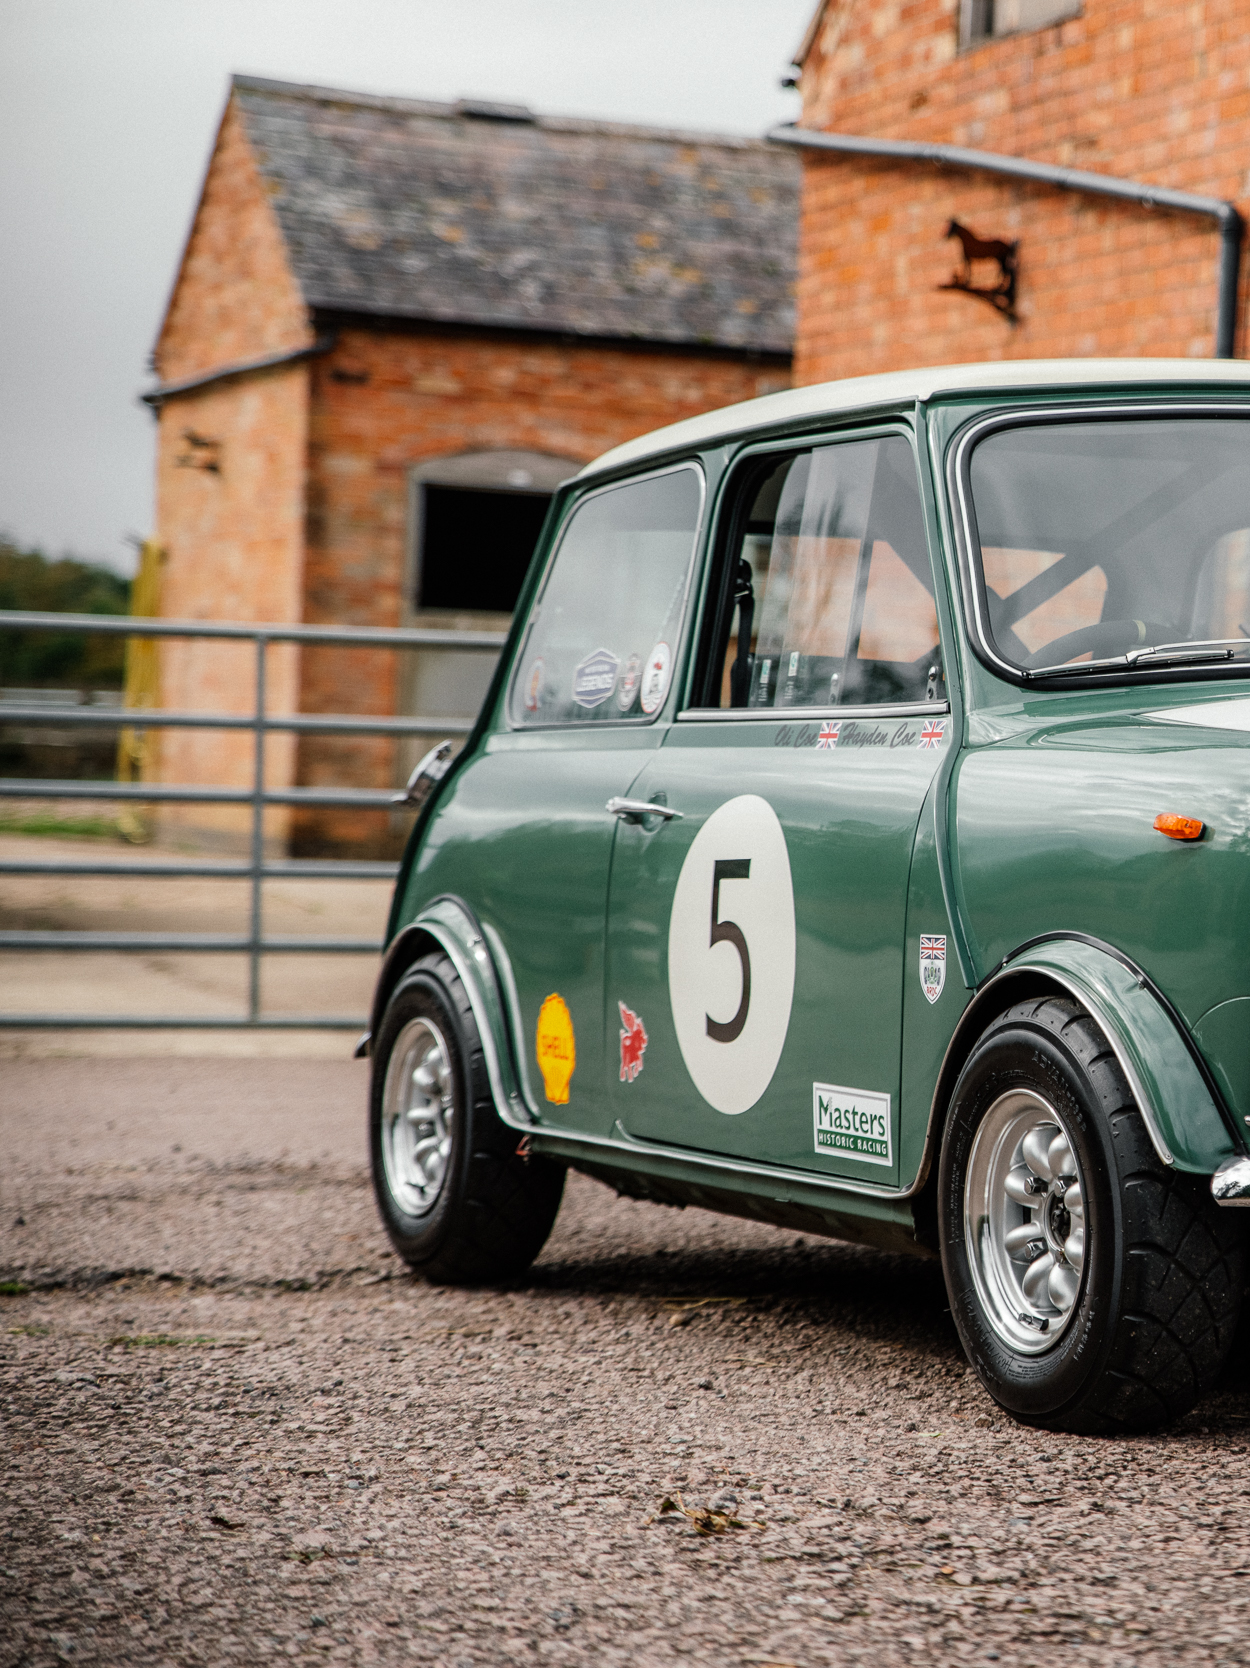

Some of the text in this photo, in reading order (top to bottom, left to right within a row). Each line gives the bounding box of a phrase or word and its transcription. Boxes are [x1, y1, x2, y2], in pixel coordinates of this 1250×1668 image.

[793, 723, 818, 749] Coe
[841, 721, 889, 750] Hayden
[889, 721, 917, 749] Coe
[705, 858, 752, 1044] 5
[818, 1094, 886, 1137] Masters
[818, 1132, 887, 1155] HISTORIC RACING
